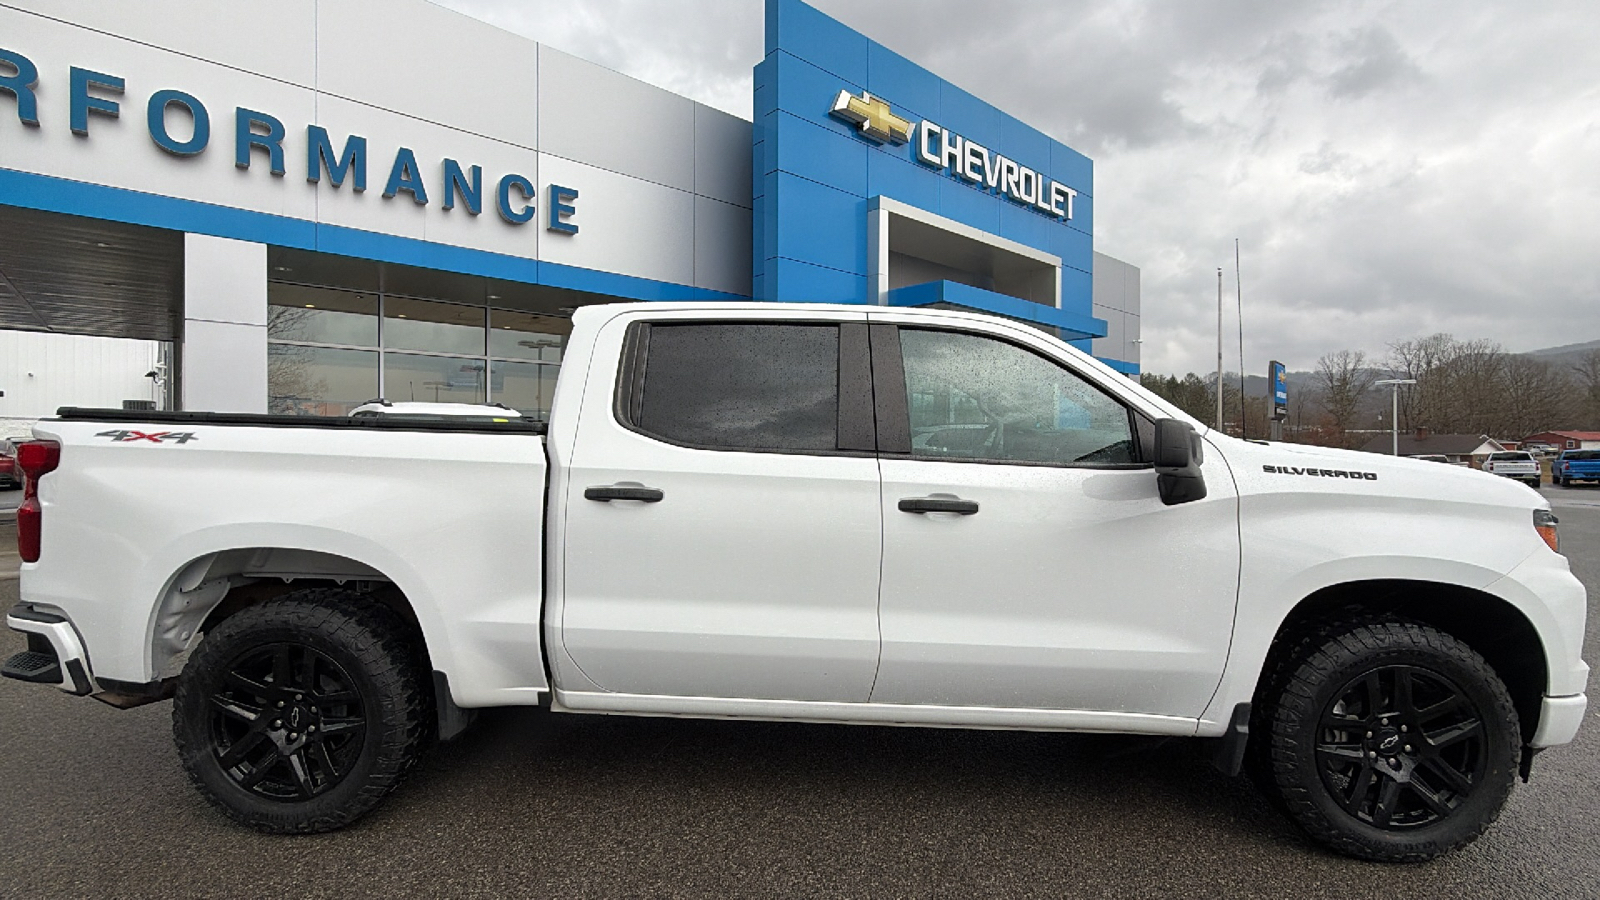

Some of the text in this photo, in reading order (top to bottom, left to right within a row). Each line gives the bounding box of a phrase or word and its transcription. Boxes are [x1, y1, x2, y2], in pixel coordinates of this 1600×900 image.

[0, 48, 579, 236] RFORMANCE
[918, 120, 1077, 220] CHEVROLET
[1263, 464, 1377, 480] SILVERADO
